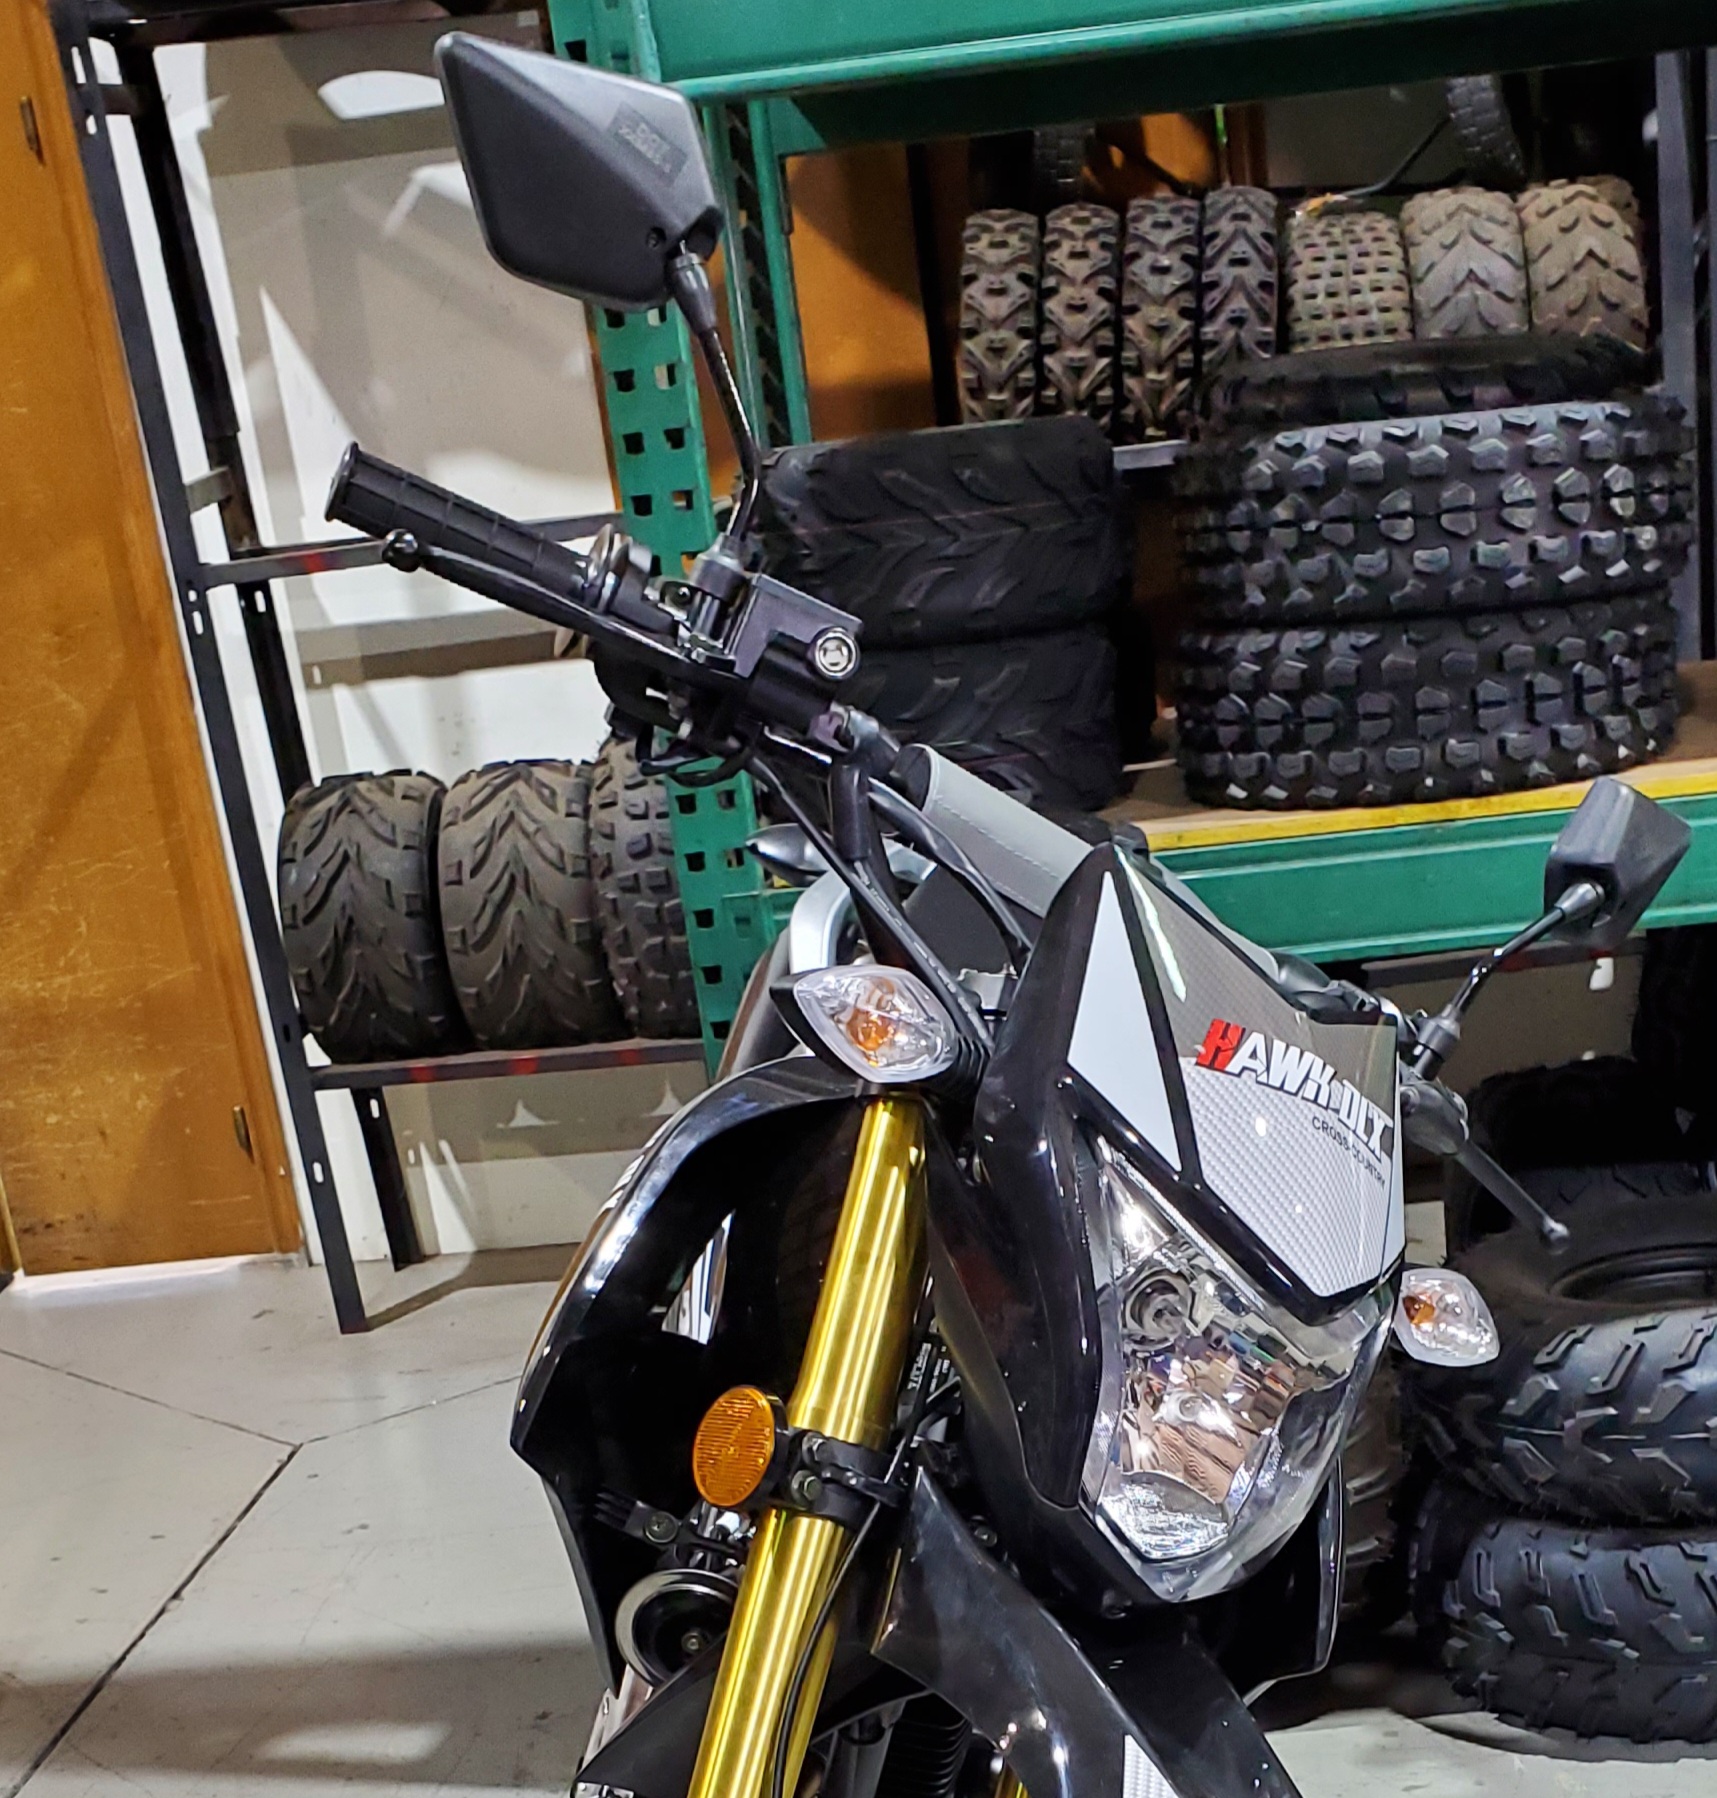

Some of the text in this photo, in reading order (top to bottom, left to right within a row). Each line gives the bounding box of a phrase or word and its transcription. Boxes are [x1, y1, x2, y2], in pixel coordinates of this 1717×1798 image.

[1195, 1018, 1389, 1162] HAWK DLX
[1312, 1115, 1350, 1151] CROSS
